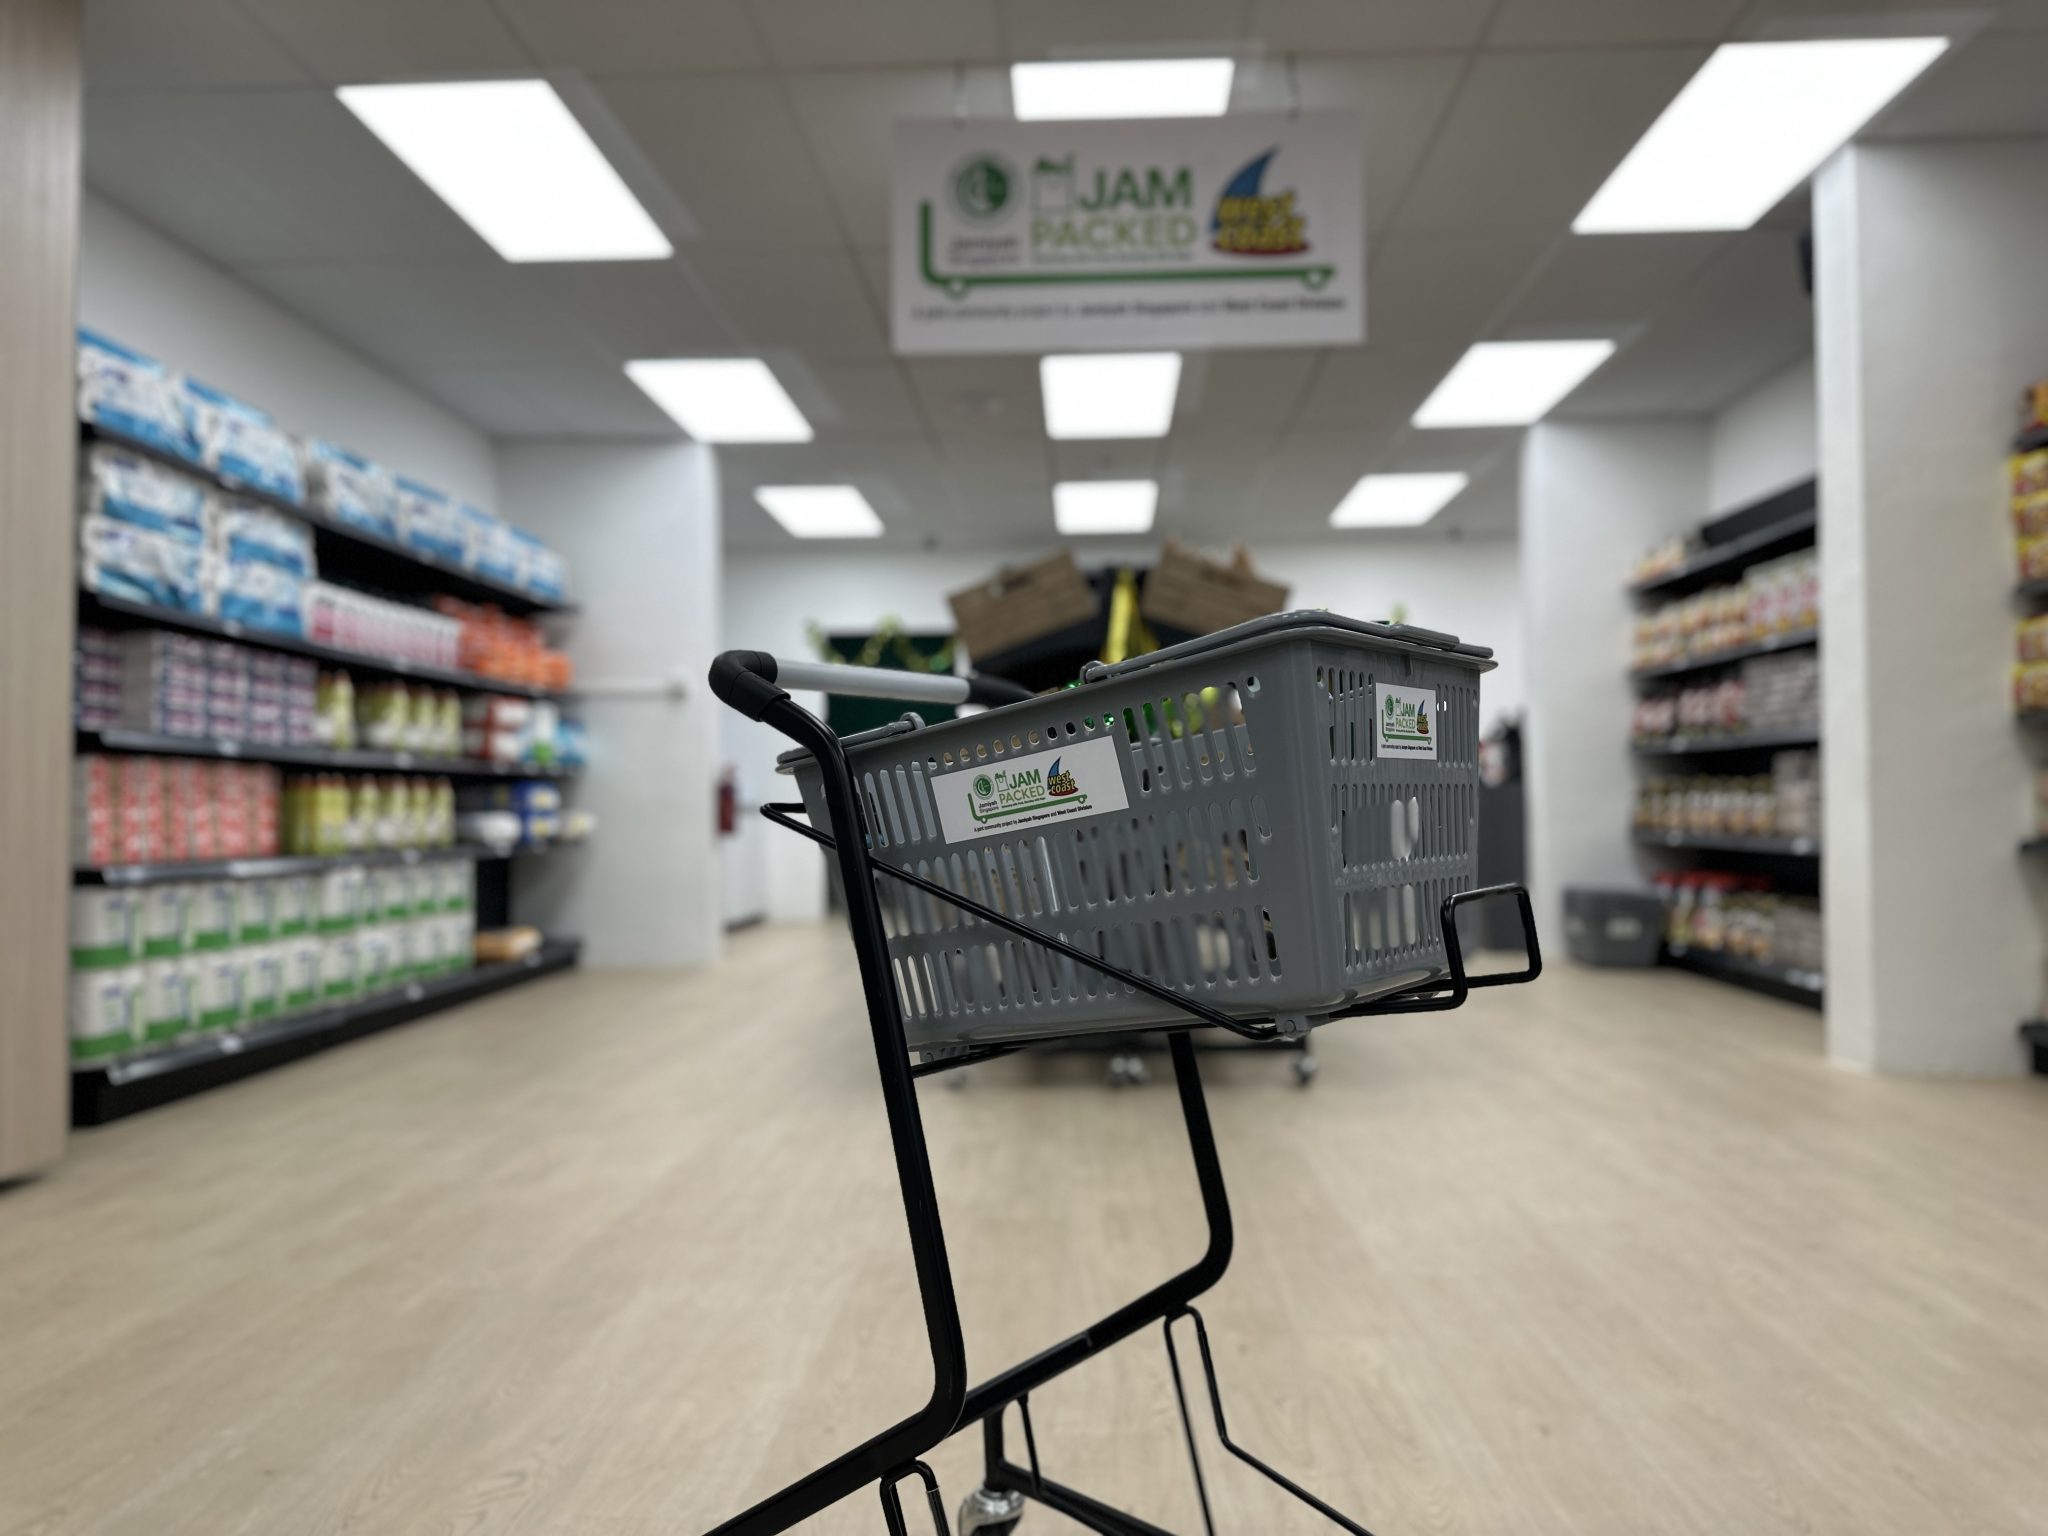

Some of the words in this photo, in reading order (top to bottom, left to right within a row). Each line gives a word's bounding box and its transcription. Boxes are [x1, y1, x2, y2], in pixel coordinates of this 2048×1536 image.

[1079, 167, 1194, 210] JAM
[1029, 214, 1198, 252] PACKED
[1401, 703, 1415, 717] JAM
[1395, 717, 1415, 729] PACKED
[1009, 769, 1041, 789] JAM
[999, 785, 1045, 804] PACKED
